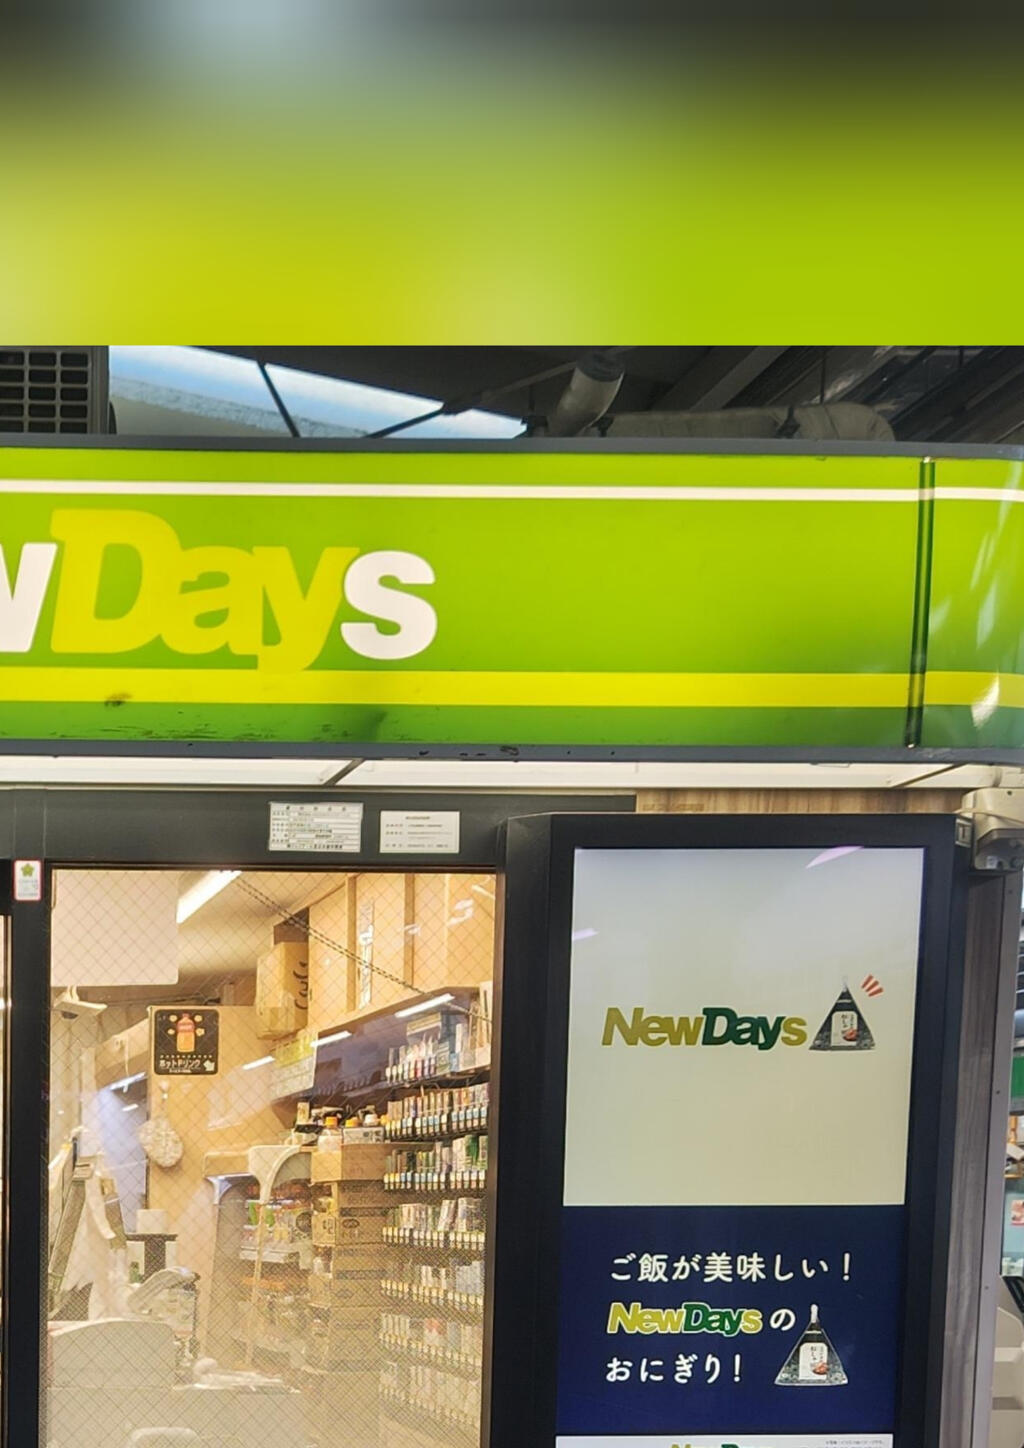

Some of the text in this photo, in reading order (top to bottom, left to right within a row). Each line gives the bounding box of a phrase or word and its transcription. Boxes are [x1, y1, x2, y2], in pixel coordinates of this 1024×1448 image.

[601, 1006, 807, 1050] NewDays
[610, 1252, 851, 1283] ご飯が美味しい！
[607, 1301, 796, 1337] NewDays の
[606, 1353, 742, 1383] おにぎり！
